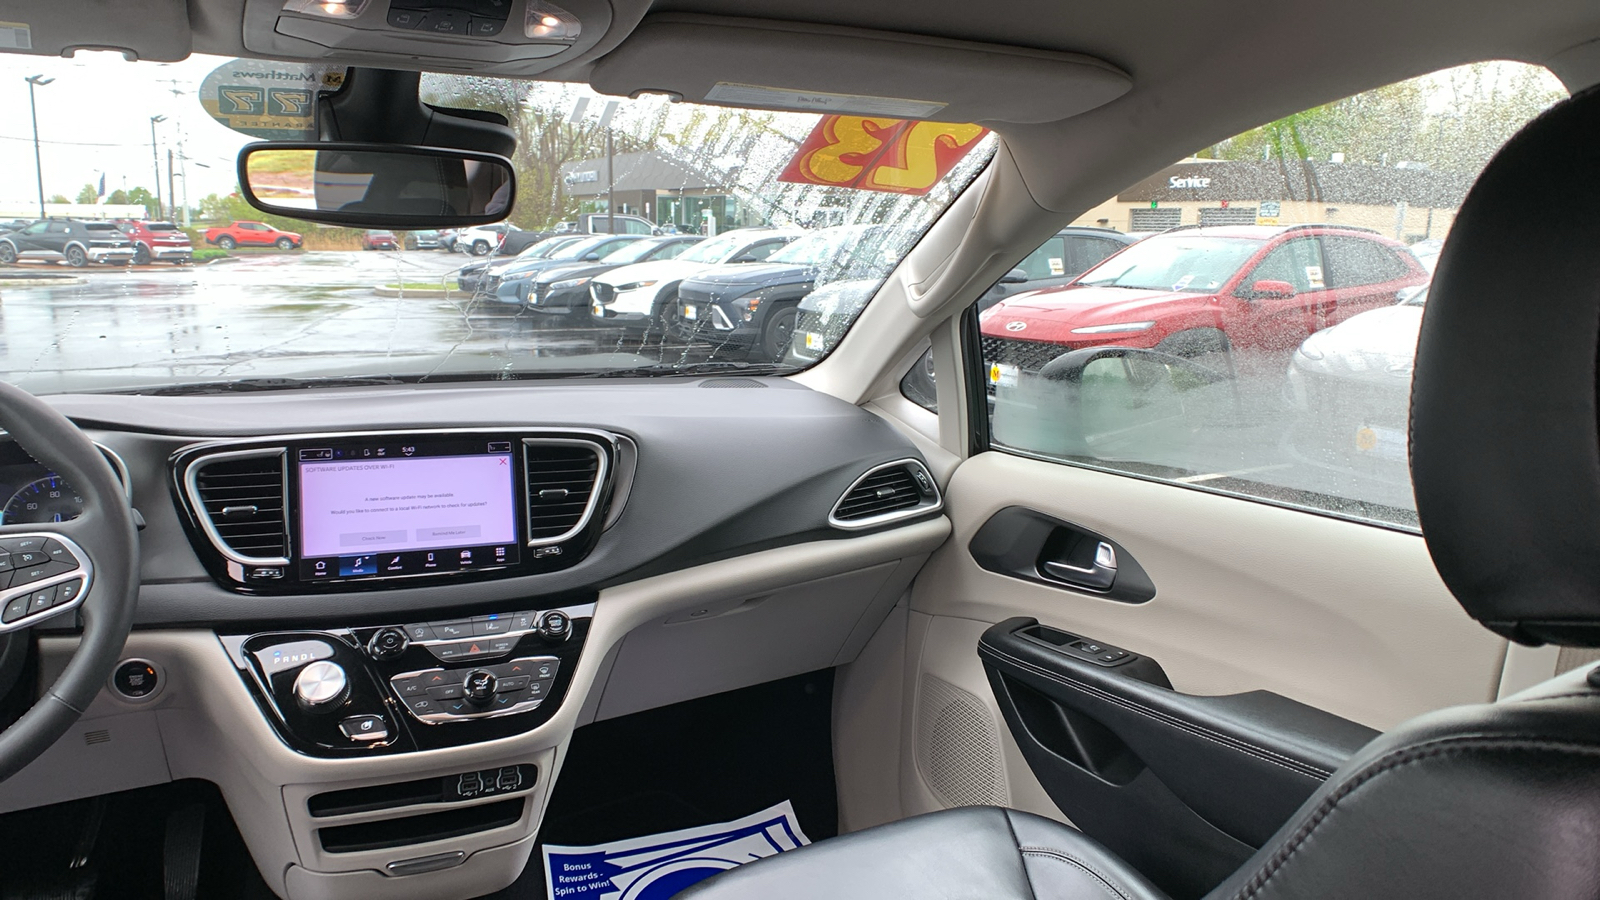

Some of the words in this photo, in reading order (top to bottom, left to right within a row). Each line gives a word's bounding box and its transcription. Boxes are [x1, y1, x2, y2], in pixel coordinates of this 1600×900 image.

[1168, 176, 1211, 188] Service
[563, 863, 592, 871] Bonus
[559, 872, 599, 883] Rewards
[555, 887, 575, 897] Spin
[588, 880, 610, 890] Win!
